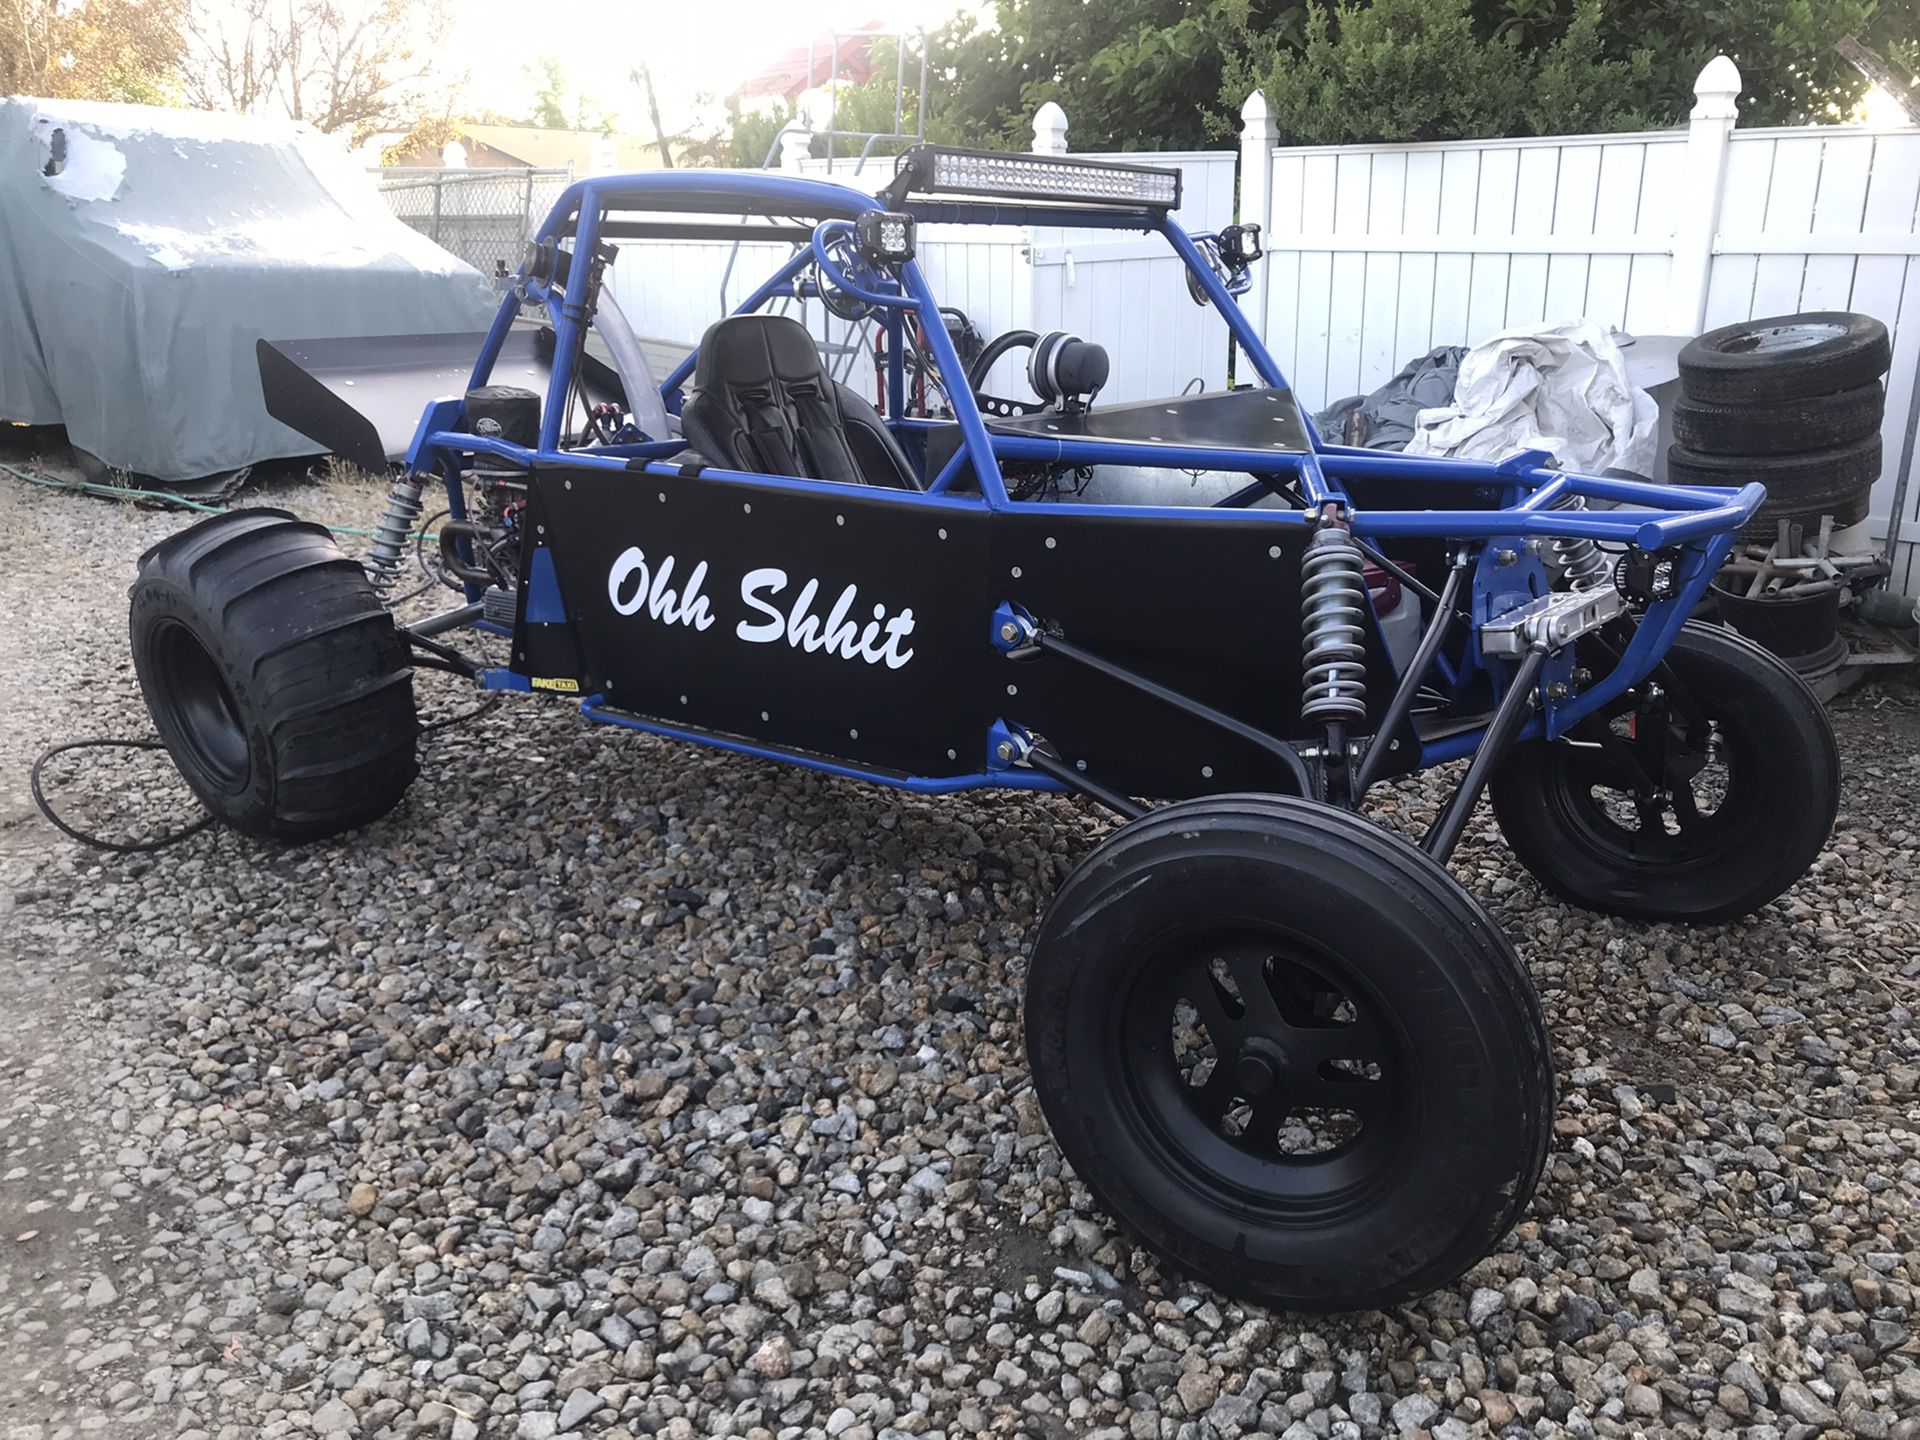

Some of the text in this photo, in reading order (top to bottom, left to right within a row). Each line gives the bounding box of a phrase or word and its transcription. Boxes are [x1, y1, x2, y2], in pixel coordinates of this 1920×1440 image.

[608, 546, 915, 669] Ohh Shhit
[556, 680, 577, 689] TAXI
